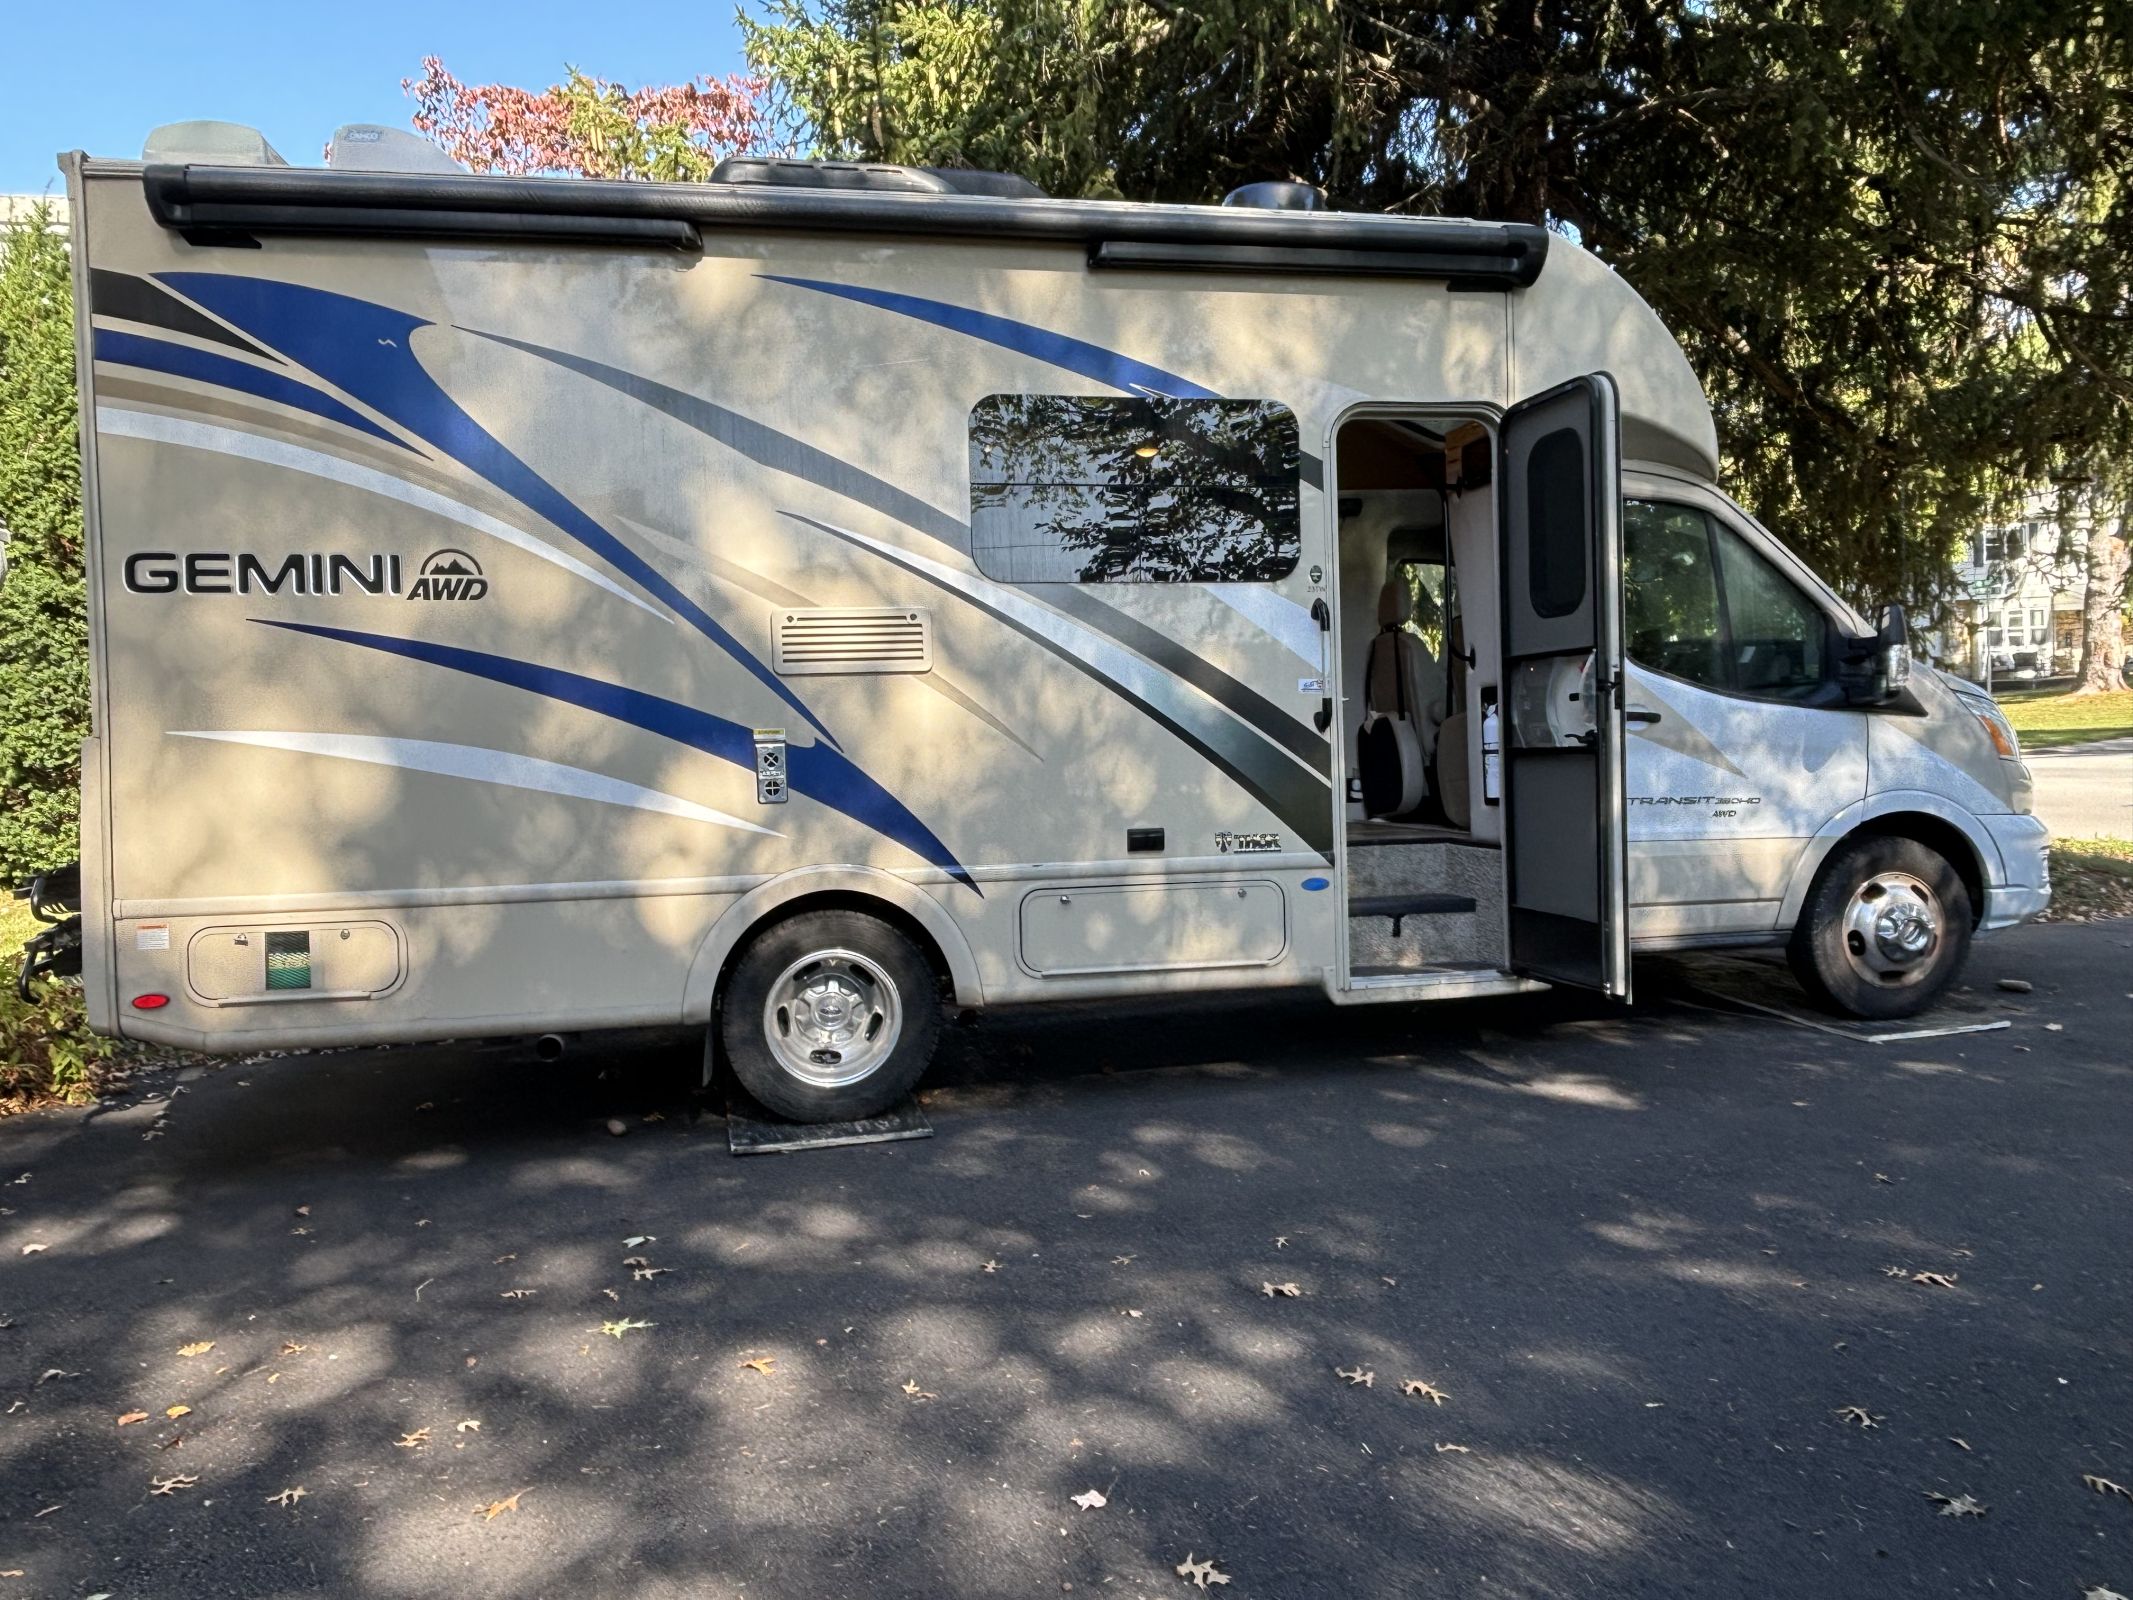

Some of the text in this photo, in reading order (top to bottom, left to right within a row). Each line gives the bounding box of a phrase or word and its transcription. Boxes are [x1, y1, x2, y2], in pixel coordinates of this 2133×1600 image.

[123, 552, 402, 596] GEMINI
[406, 577, 489, 601] AWD
[1627, 796, 1716, 806] TRANSIT
[1712, 810, 1737, 818] AWD
